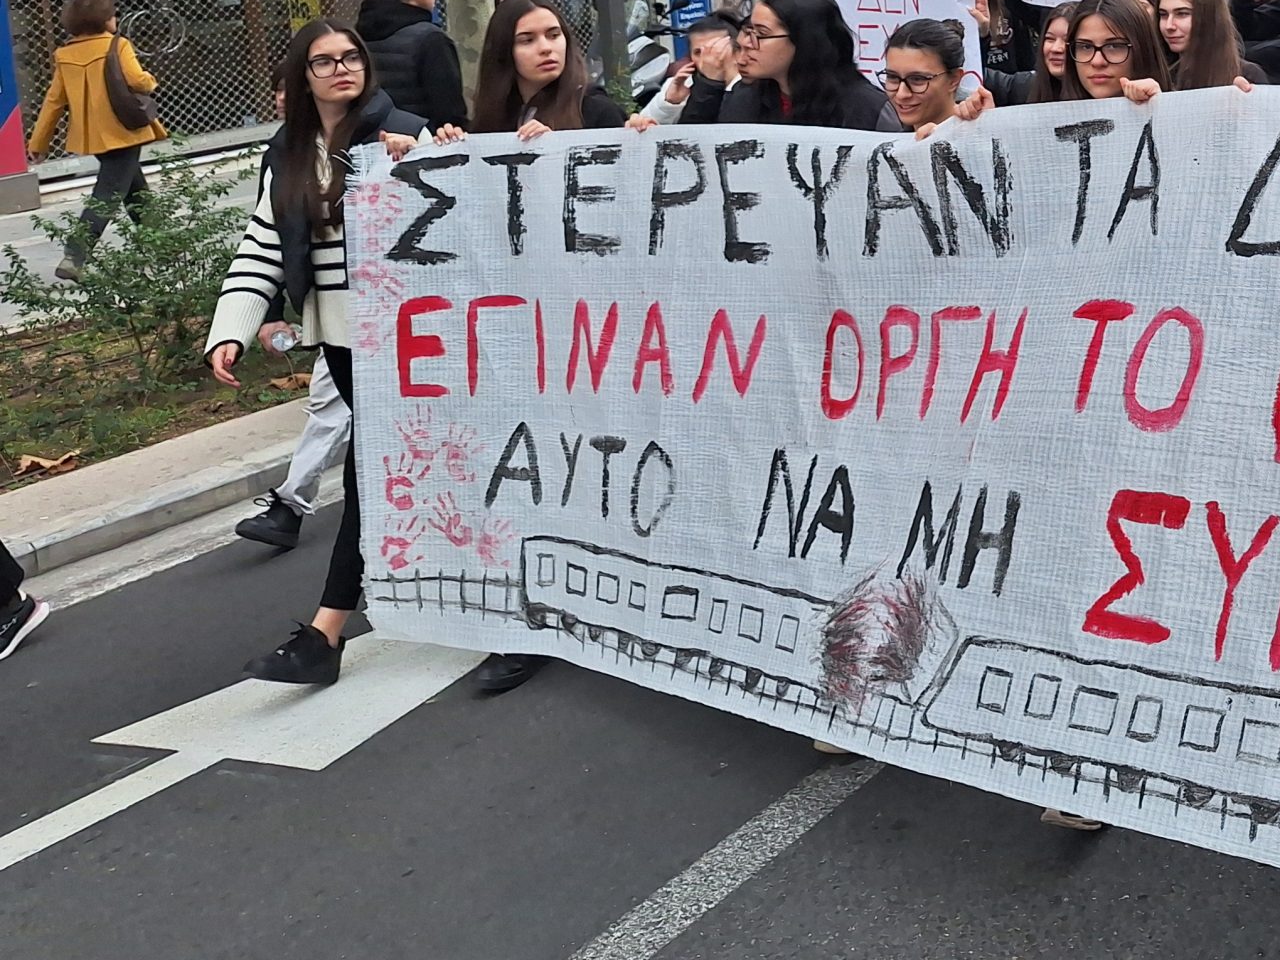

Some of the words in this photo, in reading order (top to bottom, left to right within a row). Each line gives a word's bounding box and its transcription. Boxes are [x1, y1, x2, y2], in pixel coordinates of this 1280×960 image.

[384, 138, 1014, 266] ΣΤΕΡΕΨΑΝ
[1054, 116, 1160, 244] ΤΑ
[396, 295, 766, 404] ΕΓΙΝΑΝ
[820, 305, 1027, 425] ΟΡΓΗ
[1072, 298, 1205, 433] ΤΟ
[483, 420, 675, 538] ΑΥΤΟ
[753, 446, 856, 565] ΝΑ
[896, 479, 1022, 597] ΜΗ
